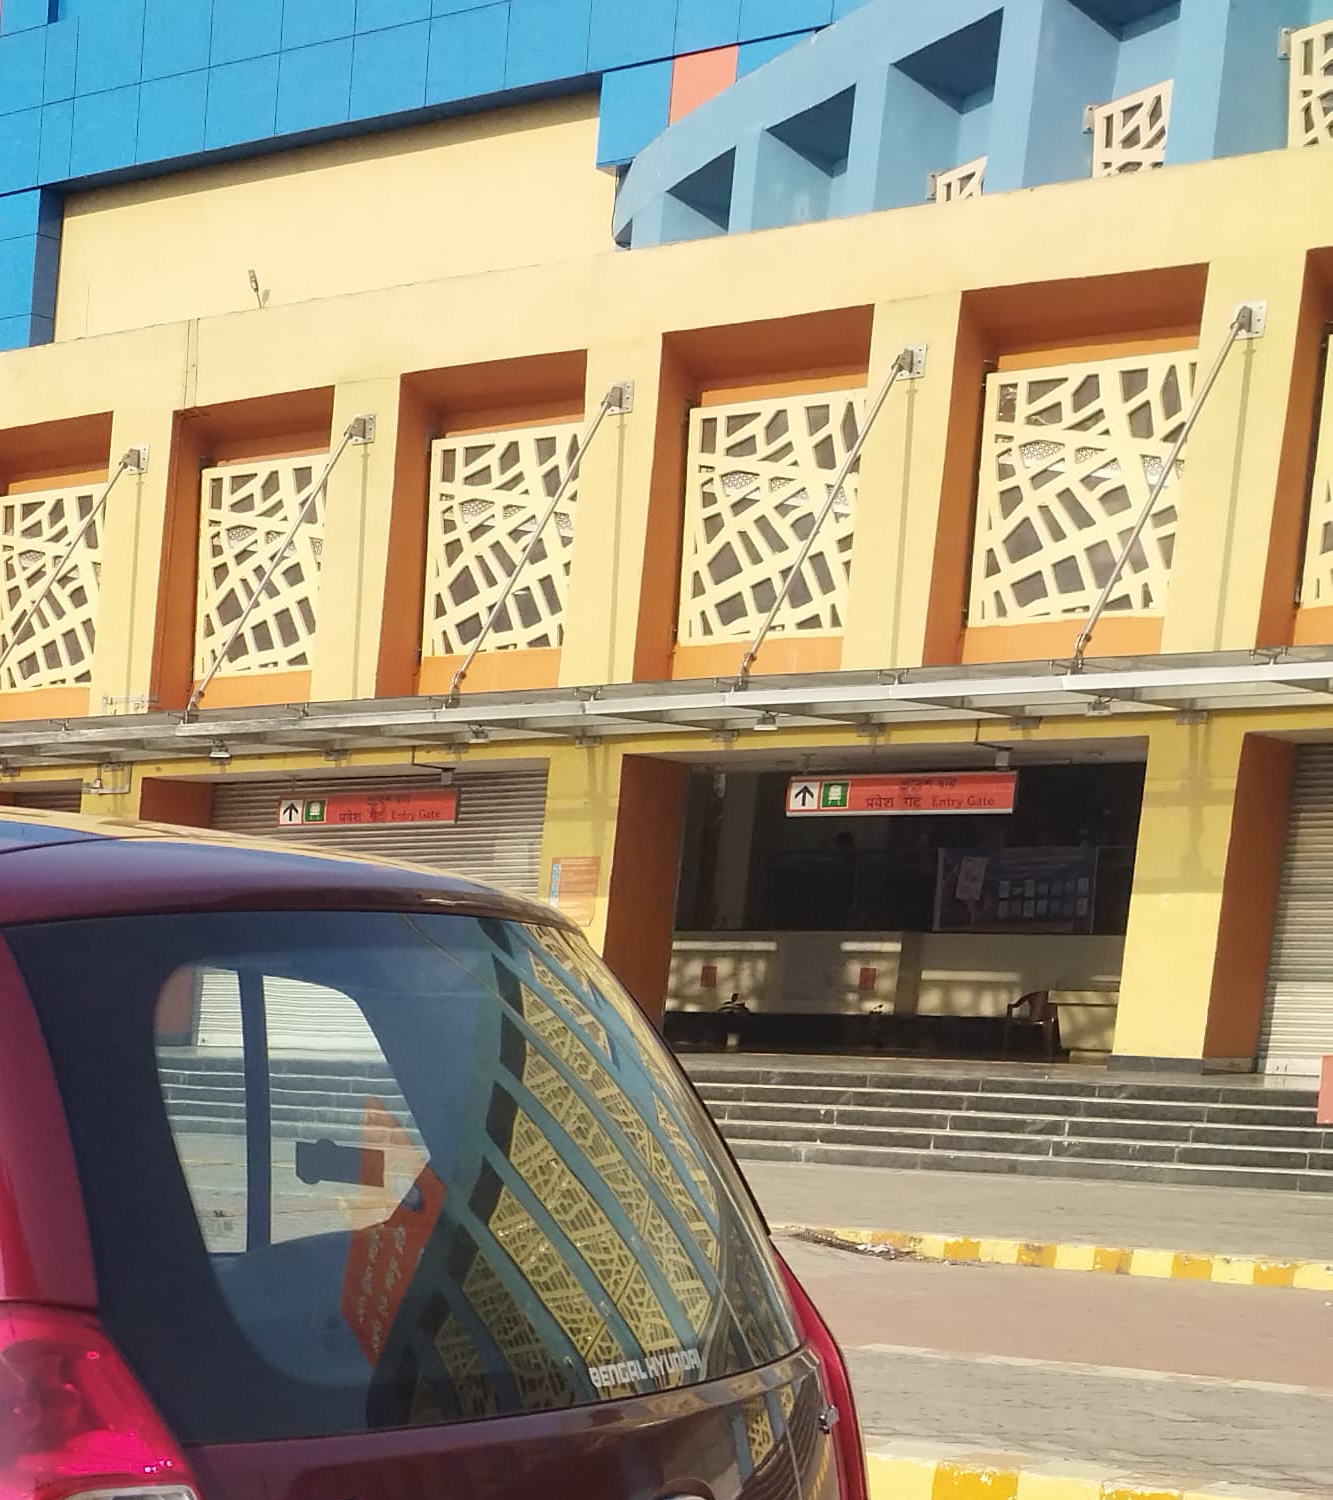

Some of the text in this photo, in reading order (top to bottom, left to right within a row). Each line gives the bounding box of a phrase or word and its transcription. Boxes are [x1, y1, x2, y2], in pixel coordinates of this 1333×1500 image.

[932, 796, 962, 808] Entry
[966, 794, 995, 807] Gate
[588, 1348, 702, 1388] BENGAL HYUNDAI
